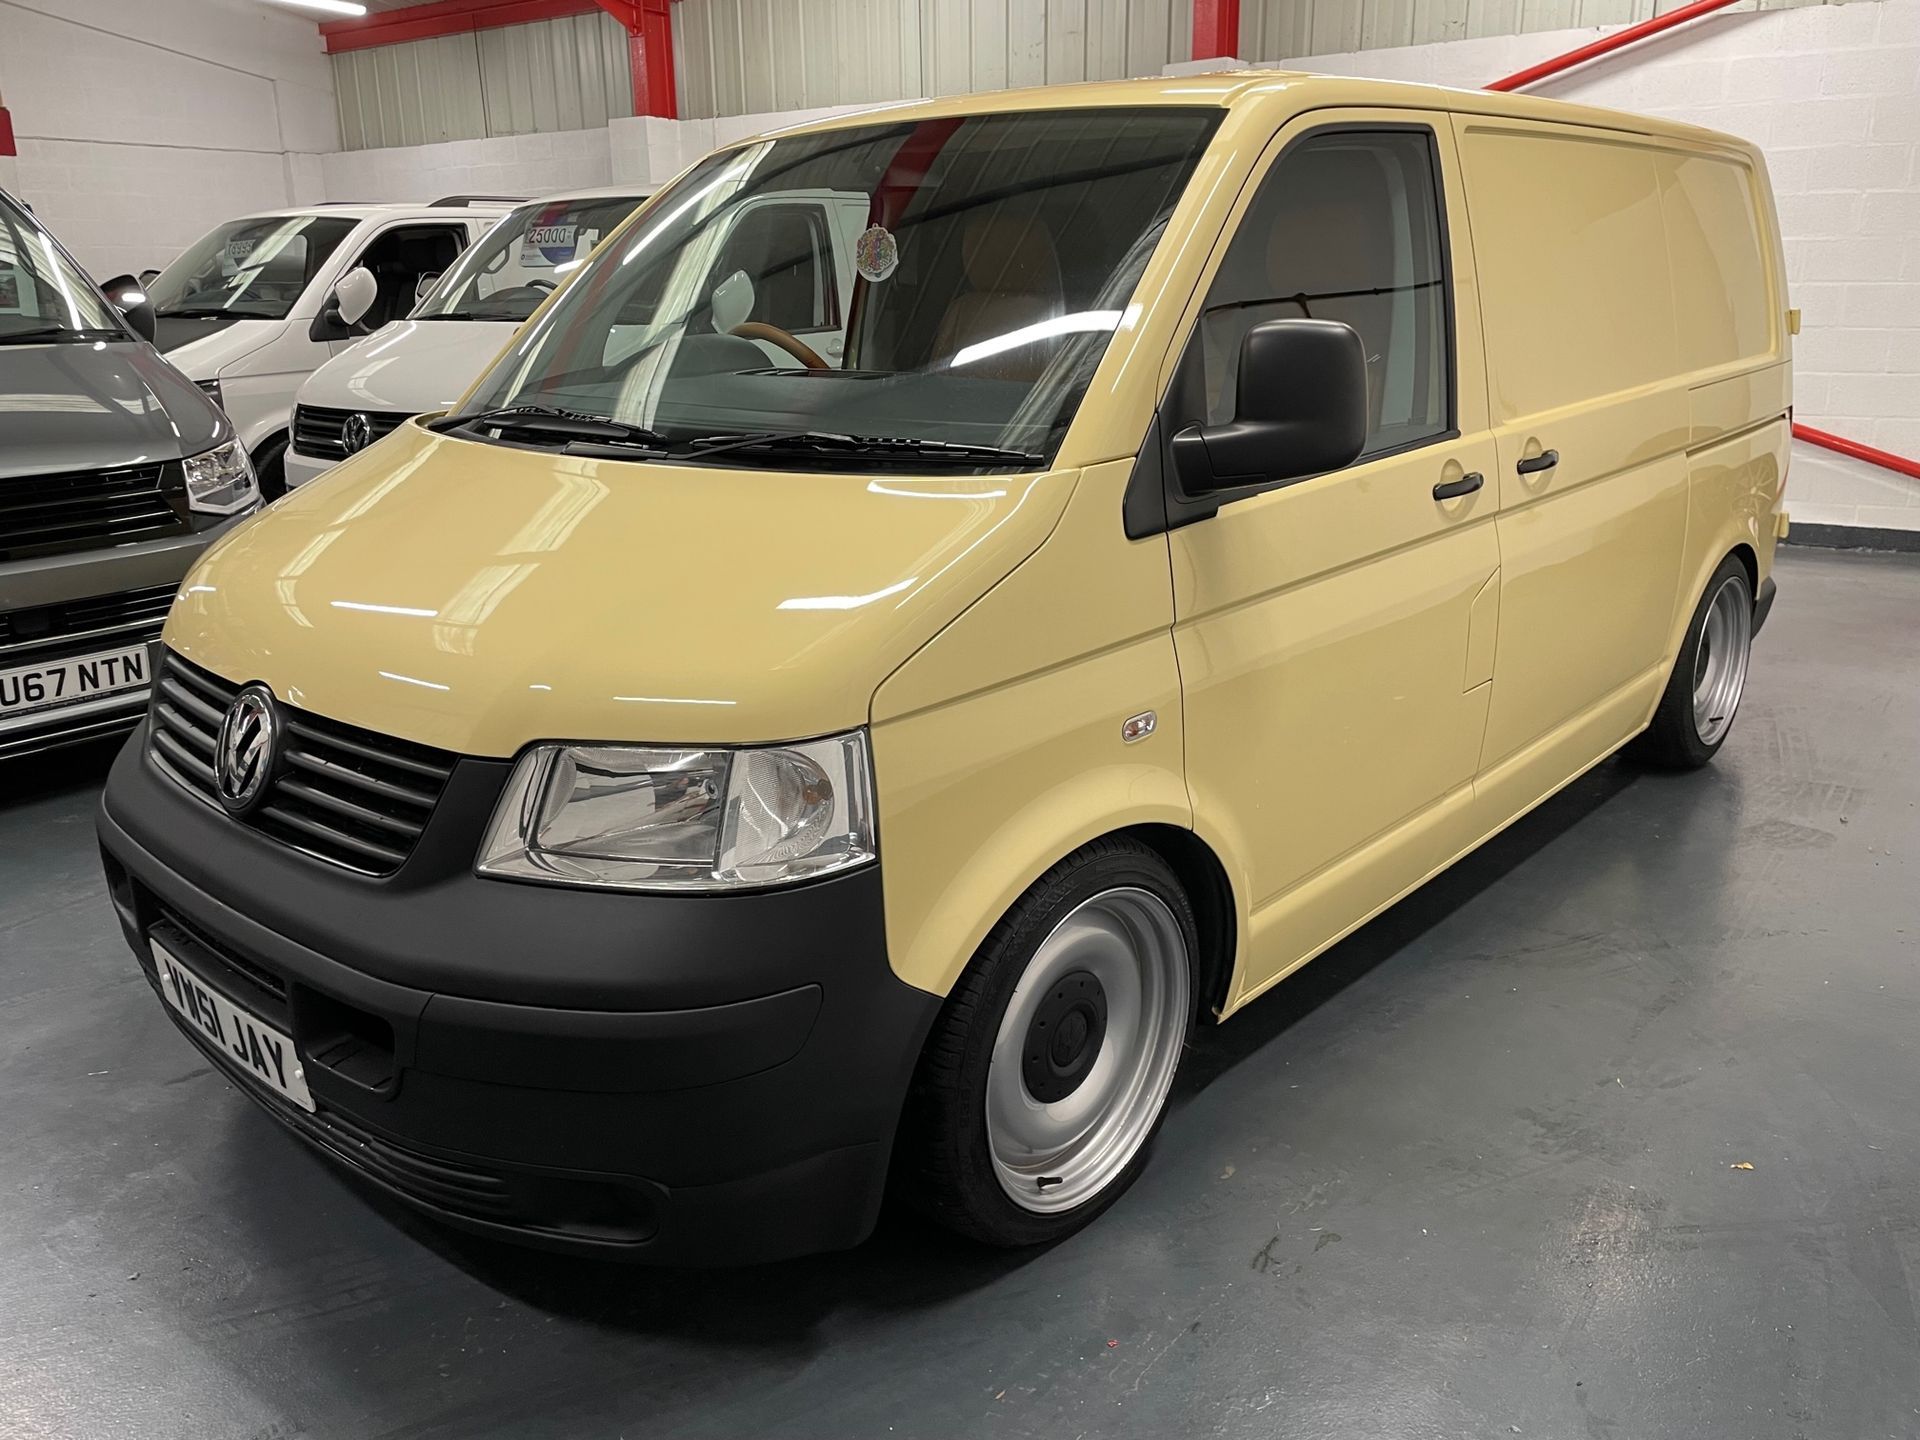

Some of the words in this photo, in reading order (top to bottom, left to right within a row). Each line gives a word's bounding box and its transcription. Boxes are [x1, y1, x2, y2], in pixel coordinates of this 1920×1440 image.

[529, 228, 567, 243] 25000
[0, 667, 66, 706] U67
[78, 653, 143, 692] NTN
[232, 1014, 287, 1089] JAY
